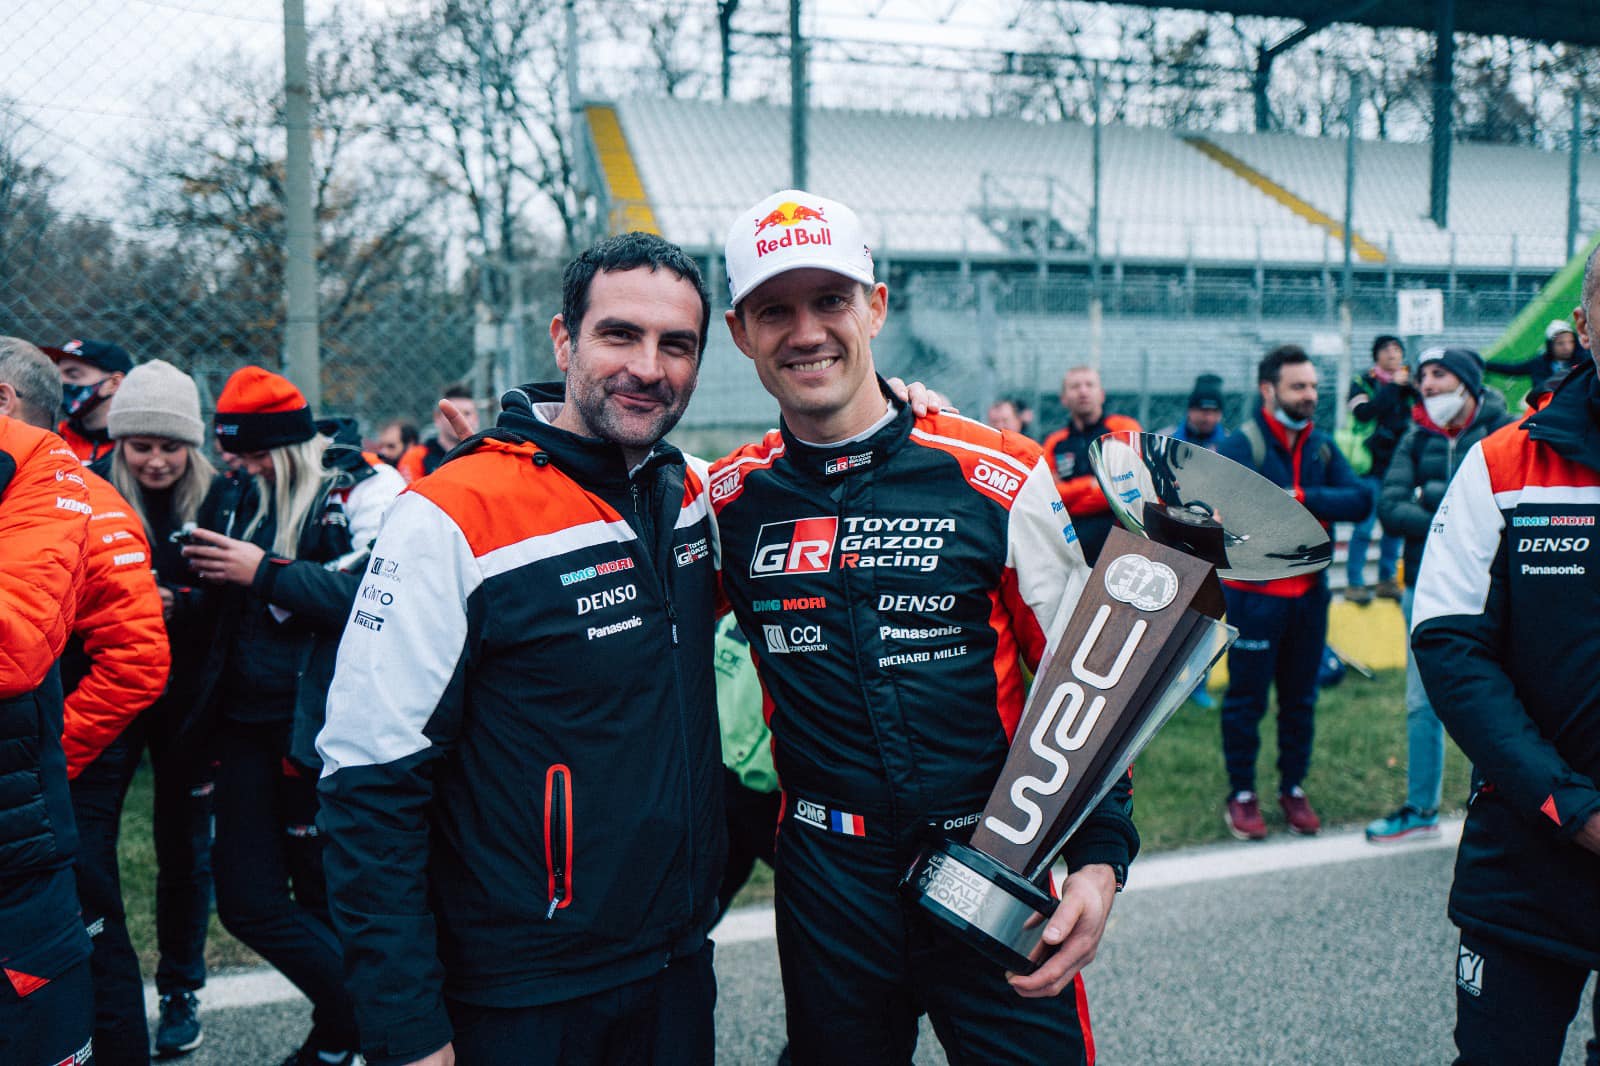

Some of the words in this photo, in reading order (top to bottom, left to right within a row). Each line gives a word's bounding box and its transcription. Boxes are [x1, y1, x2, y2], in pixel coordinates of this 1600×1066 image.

[755, 228, 793, 258] Red
[794, 227, 832, 246] Bull
[711, 471, 741, 499] OMP
[973, 463, 1019, 494] OMP
[842, 516, 957, 533] TOYOTA
[1513, 516, 1549, 527] DMG
[1550, 515, 1596, 526] MORI
[840, 534, 944, 551] GAZOO
[1517, 537, 1590, 553] DENSO
[753, 540, 831, 573] GR
[839, 551, 939, 573] Racing
[560, 566, 597, 586] DMG
[596, 556, 635, 576] MORI
[1521, 564, 1586, 576] Panasonic
[576, 583, 638, 616] DENSO
[752, 600, 781, 612] DMG
[783, 596, 827, 611] MORI
[877, 594, 956, 612] DENSO
[587, 615, 643, 641] Panasonic
[790, 625, 822, 645] CCI
[879, 625, 963, 641] Panasonic
[878, 652, 931, 668] RICHARD
[933, 645, 968, 660] MILLE
[796, 800, 827, 825] OMP
